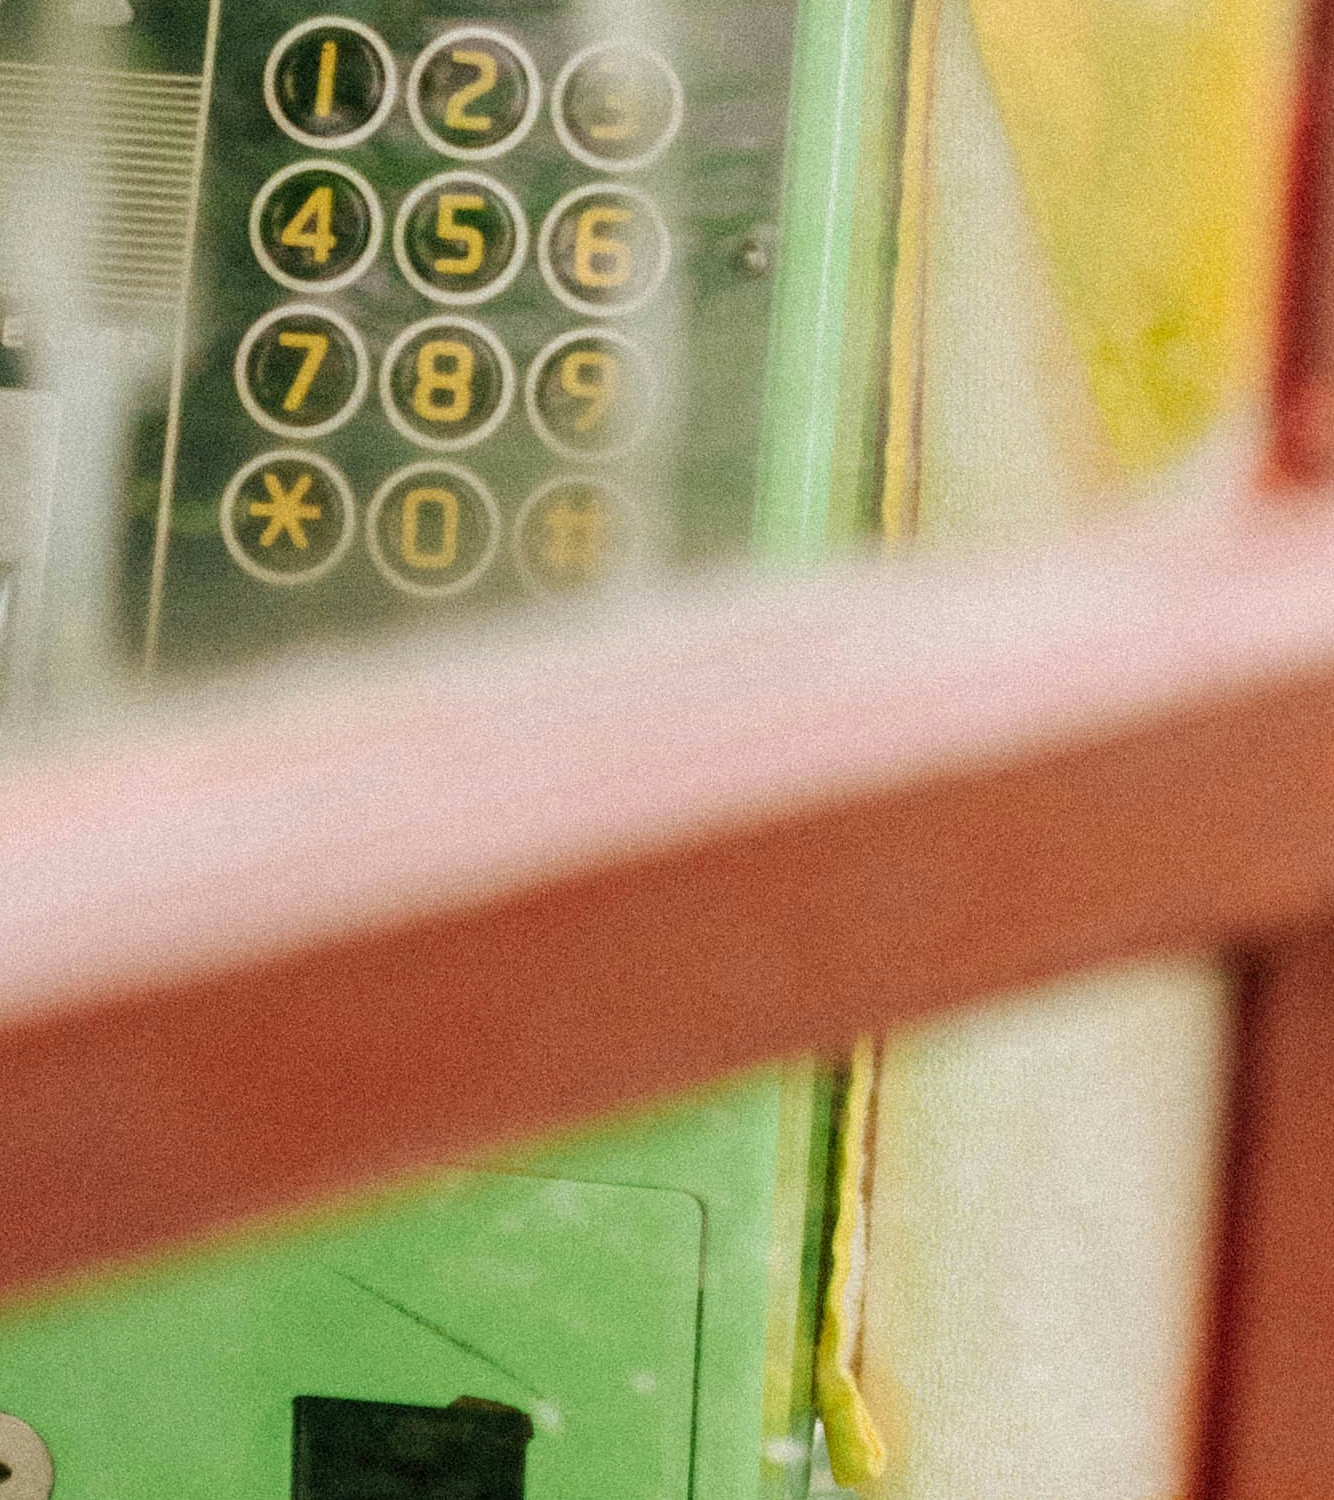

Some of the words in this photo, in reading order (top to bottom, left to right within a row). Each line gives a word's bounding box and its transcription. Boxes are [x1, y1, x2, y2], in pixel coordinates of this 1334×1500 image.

[313, 38, 339, 119] 1
[443, 49, 499, 131] 2
[279, 185, 336, 265] 4
[433, 195, 485, 276] 5
[573, 206, 632, 288] 6
[278, 331, 330, 412] 7
[412, 339, 473, 422] 8
[560, 350, 617, 433] 9
[401, 487, 459, 570] 0
